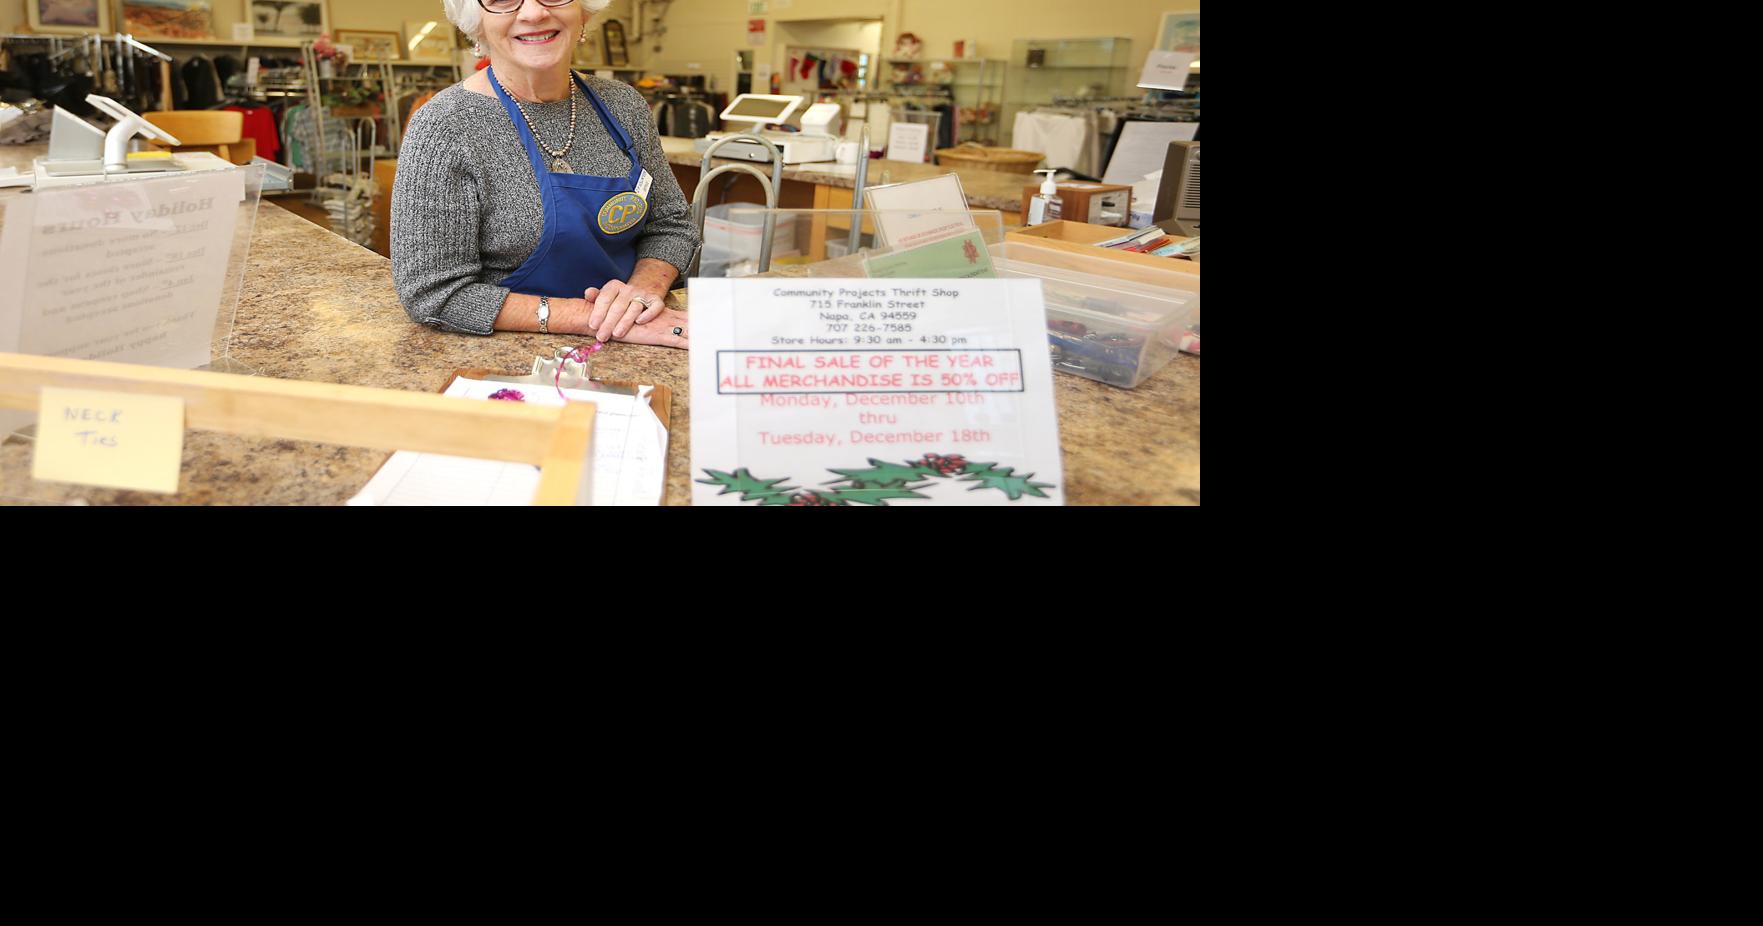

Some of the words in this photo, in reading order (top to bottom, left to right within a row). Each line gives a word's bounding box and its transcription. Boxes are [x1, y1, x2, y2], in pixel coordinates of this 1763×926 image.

[609, 204, 637, 223] CP
[773, 288, 834, 298] Community
[839, 289, 886, 299] Projects
[893, 288, 926, 297] Thrift
[932, 288, 959, 298] Shop
[810, 300, 831, 309] 715
[837, 300, 882, 309] Franklin
[888, 300, 925, 309] Street
[819, 312, 854, 321] Napa,
[860, 312, 875, 320] CA
[880, 312, 917, 320] 94559
[827, 323, 848, 332] 707
[854, 323, 912, 332] 226-7585
[771, 336, 803, 344] Store
[810, 336, 847, 344] Hours:
[854, 336, 880, 344] 9:30
[920, 336, 946, 344] 4:30
[952, 336, 967, 344] pm
[745, 356, 806, 369] FINAL
[813, 355, 862, 369] SALE
[869, 355, 893, 369] OF
[902, 354, 940, 369] THE
[946, 354, 994, 368] YEAR
[720, 375, 755, 388] ALL
[762, 373, 903, 388] MERCHANDISE
[910, 373, 934, 388] IS
[939, 372, 978, 387] 50%
[984, 371, 1020, 386] OFF
[760, 393, 837, 409] Monday,
[845, 392, 936, 405] December
[944, 391, 985, 405] 10th
[63, 407, 123, 423] NECK
[859, 411, 898, 425] thru
[757, 431, 843, 446] Tuesday,
[849, 429, 943, 443] December
[951, 428, 991, 442] 18th
